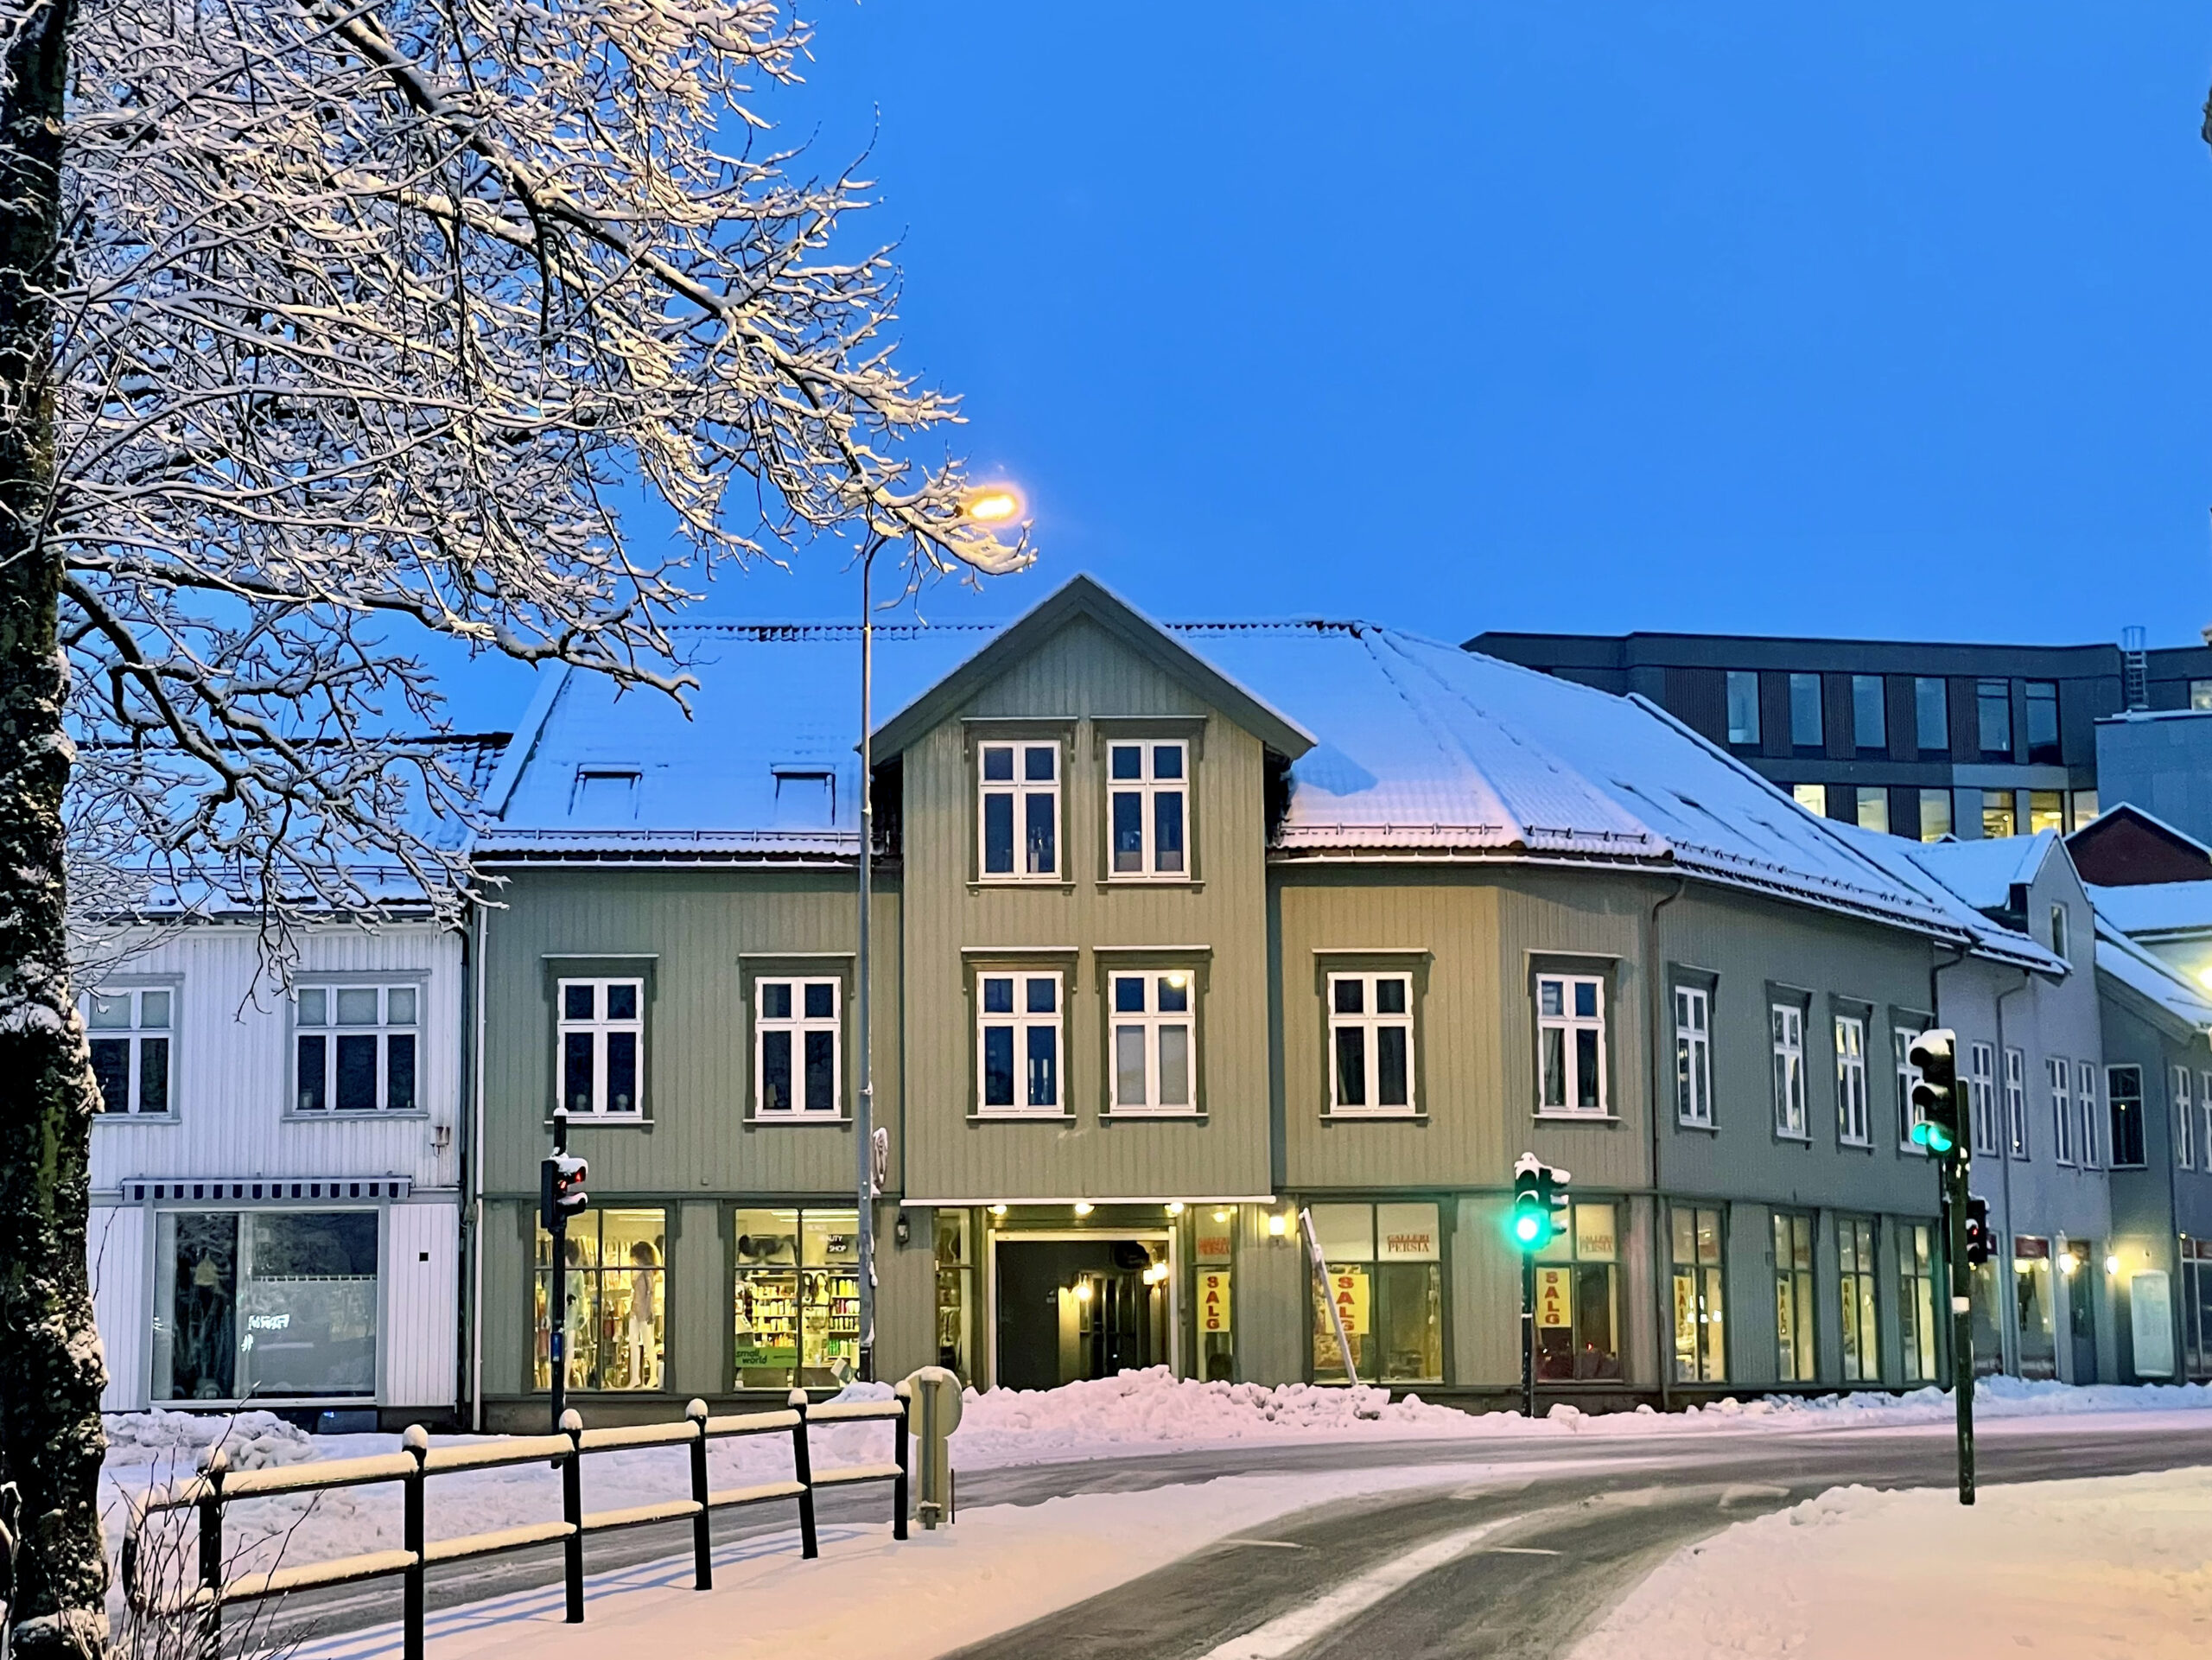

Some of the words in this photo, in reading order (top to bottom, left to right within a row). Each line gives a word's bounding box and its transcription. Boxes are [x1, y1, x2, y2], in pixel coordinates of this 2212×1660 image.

[1388, 1243, 1429, 1252] PERSIA
[1206, 1275, 1219, 1329] SALG
[1337, 1276, 1355, 1332] SALG
[1545, 1271, 1560, 1325] SALG
[736, 1348, 760, 1358] small
[743, 1355, 766, 1364] world
